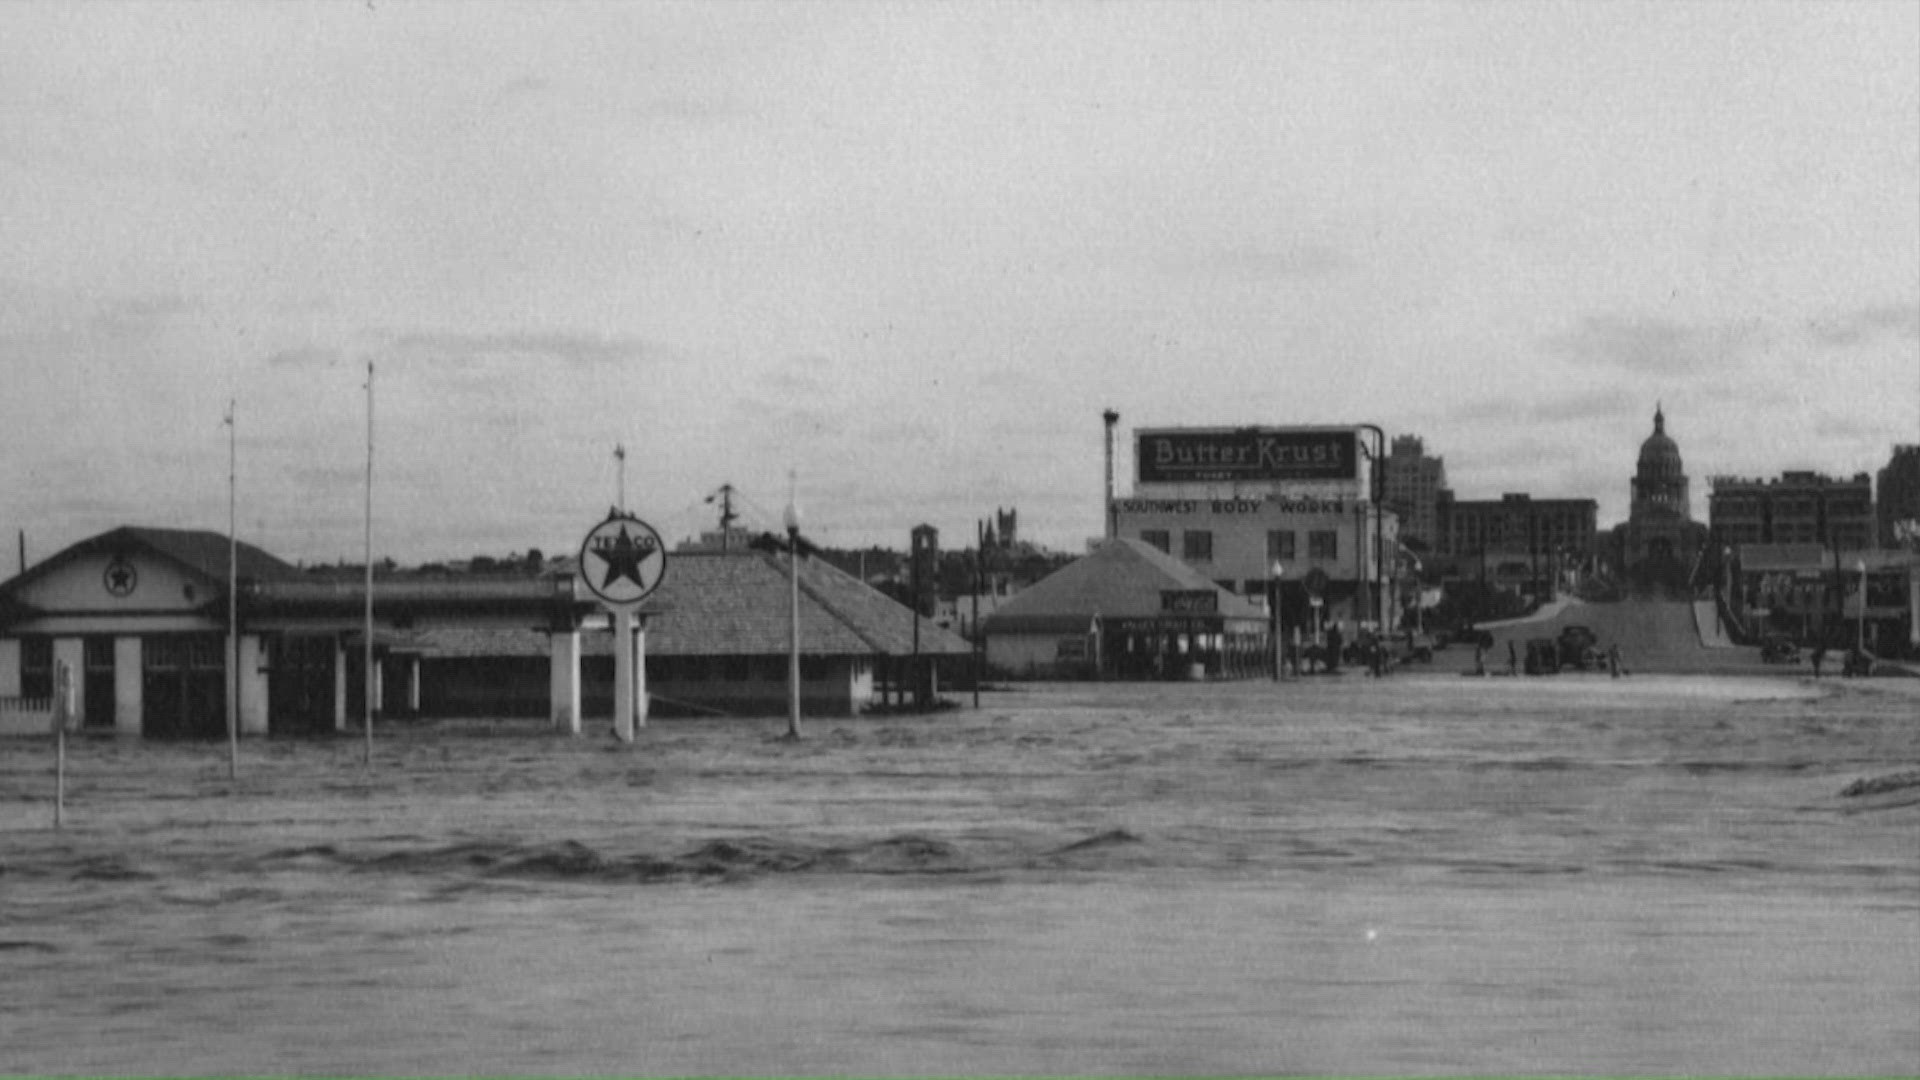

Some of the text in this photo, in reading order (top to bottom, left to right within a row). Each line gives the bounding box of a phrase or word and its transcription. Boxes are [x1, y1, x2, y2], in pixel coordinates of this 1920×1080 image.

[1155, 437, 1341, 469] Butter Krust
[1123, 501, 1343, 514] SOUTHWEST BODY WORKS
[594, 536, 655, 550] TECO
